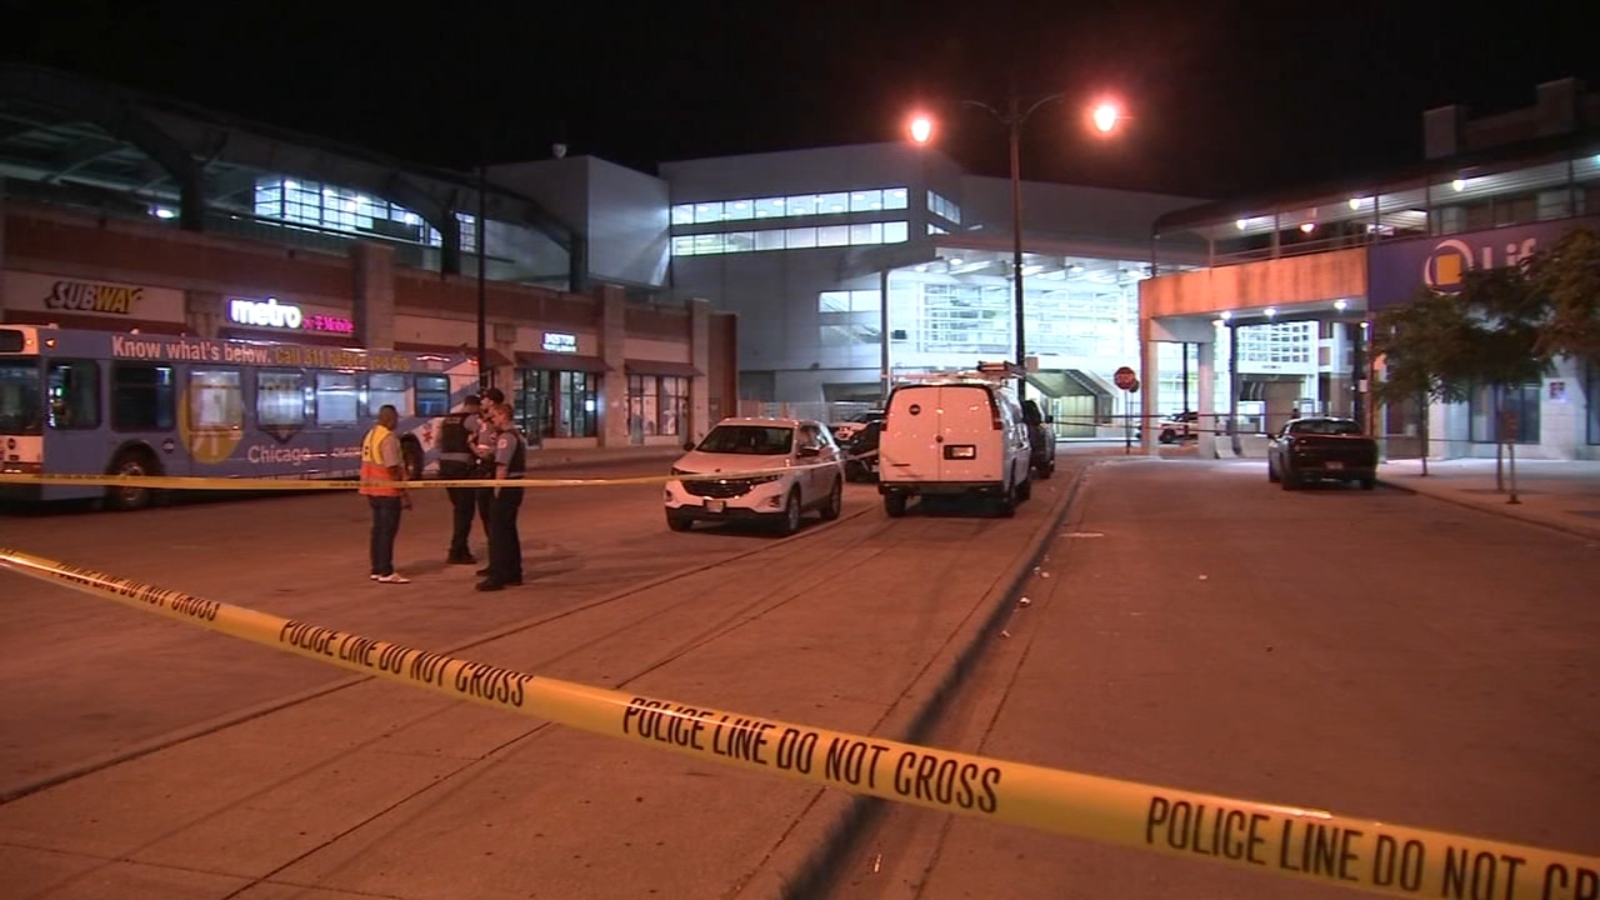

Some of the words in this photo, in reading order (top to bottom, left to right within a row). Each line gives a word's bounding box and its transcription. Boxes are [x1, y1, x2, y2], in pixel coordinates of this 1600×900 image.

[43, 280, 143, 314] SUBWAY
[230, 298, 301, 328] metro
[112, 335, 161, 359] Know
[166, 339, 221, 361] what's
[224, 343, 271, 363] below.
[248, 445, 311, 466] Chicago
[170, 592, 220, 622] CROSS
[279, 619, 338, 657] POLICE
[339, 634, 377, 667] LINE
[378, 643, 414, 675] DO
[410, 651, 455, 687] NOT
[455, 660, 534, 708] CROSS
[623, 697, 713, 751] POLICE
[712, 715, 776, 764] LINE
[776, 728, 819, 774] DO
[825, 737, 890, 789] NOT
[893, 751, 1002, 814] CROSS
[1146, 796, 1271, 866] POLICE
[1280, 819, 1364, 882] LINE
[1373, 834, 1426, 892] DO
[1441, 846, 1527, 900] NOT
